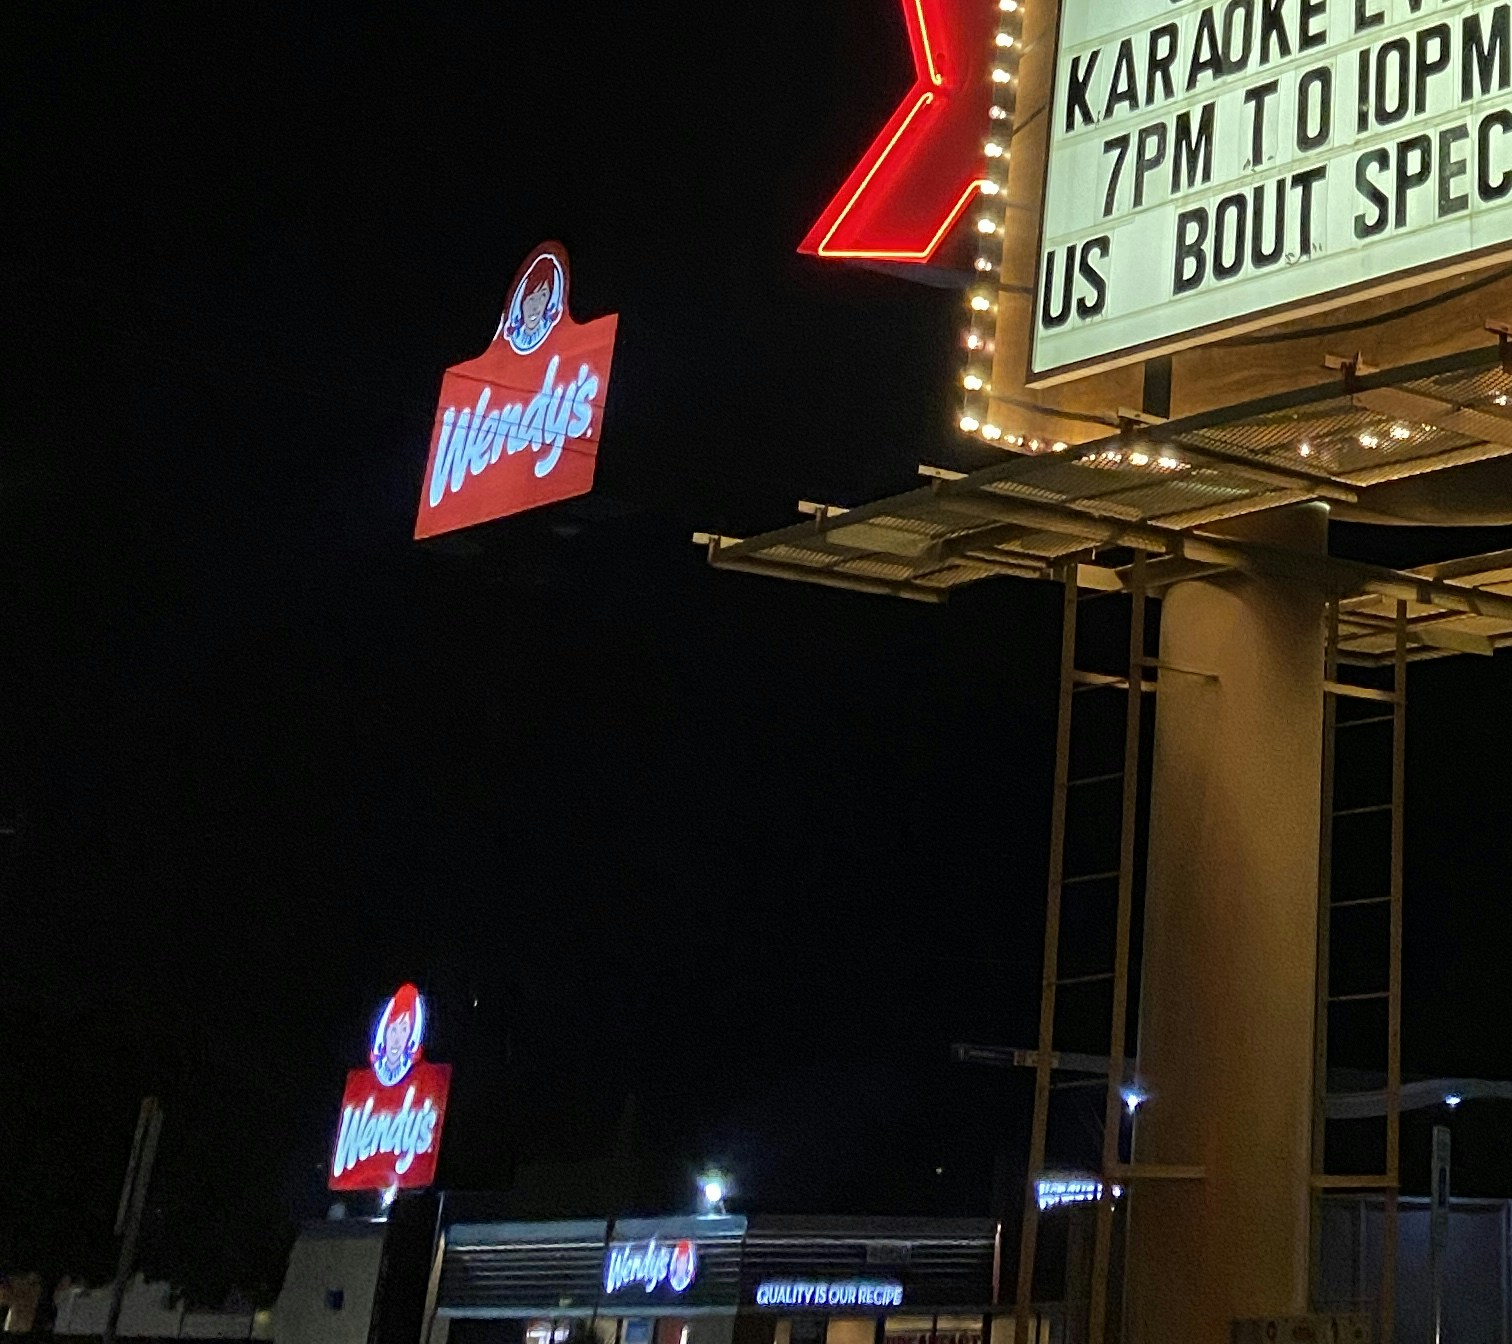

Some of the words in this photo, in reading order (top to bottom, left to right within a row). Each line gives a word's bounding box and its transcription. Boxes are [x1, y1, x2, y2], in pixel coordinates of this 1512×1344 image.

[1101, 102, 1217, 217] 7PM
[1244, 65, 1332, 169] TO
[1356, 3, 1512, 133] 10PM
[1041, 235, 1111, 329] US
[1173, 164, 1327, 297] BOUT
[429, 355, 599, 507] Wendy's
[334, 1085, 436, 1177] Wendy's
[606, 1236, 670, 1293] Wendy's
[757, 1283, 814, 1306] QUALITY
[815, 1284, 826, 1305] IS
[828, 1284, 856, 1305] OUR
[858, 1283, 903, 1306] RECIPE
